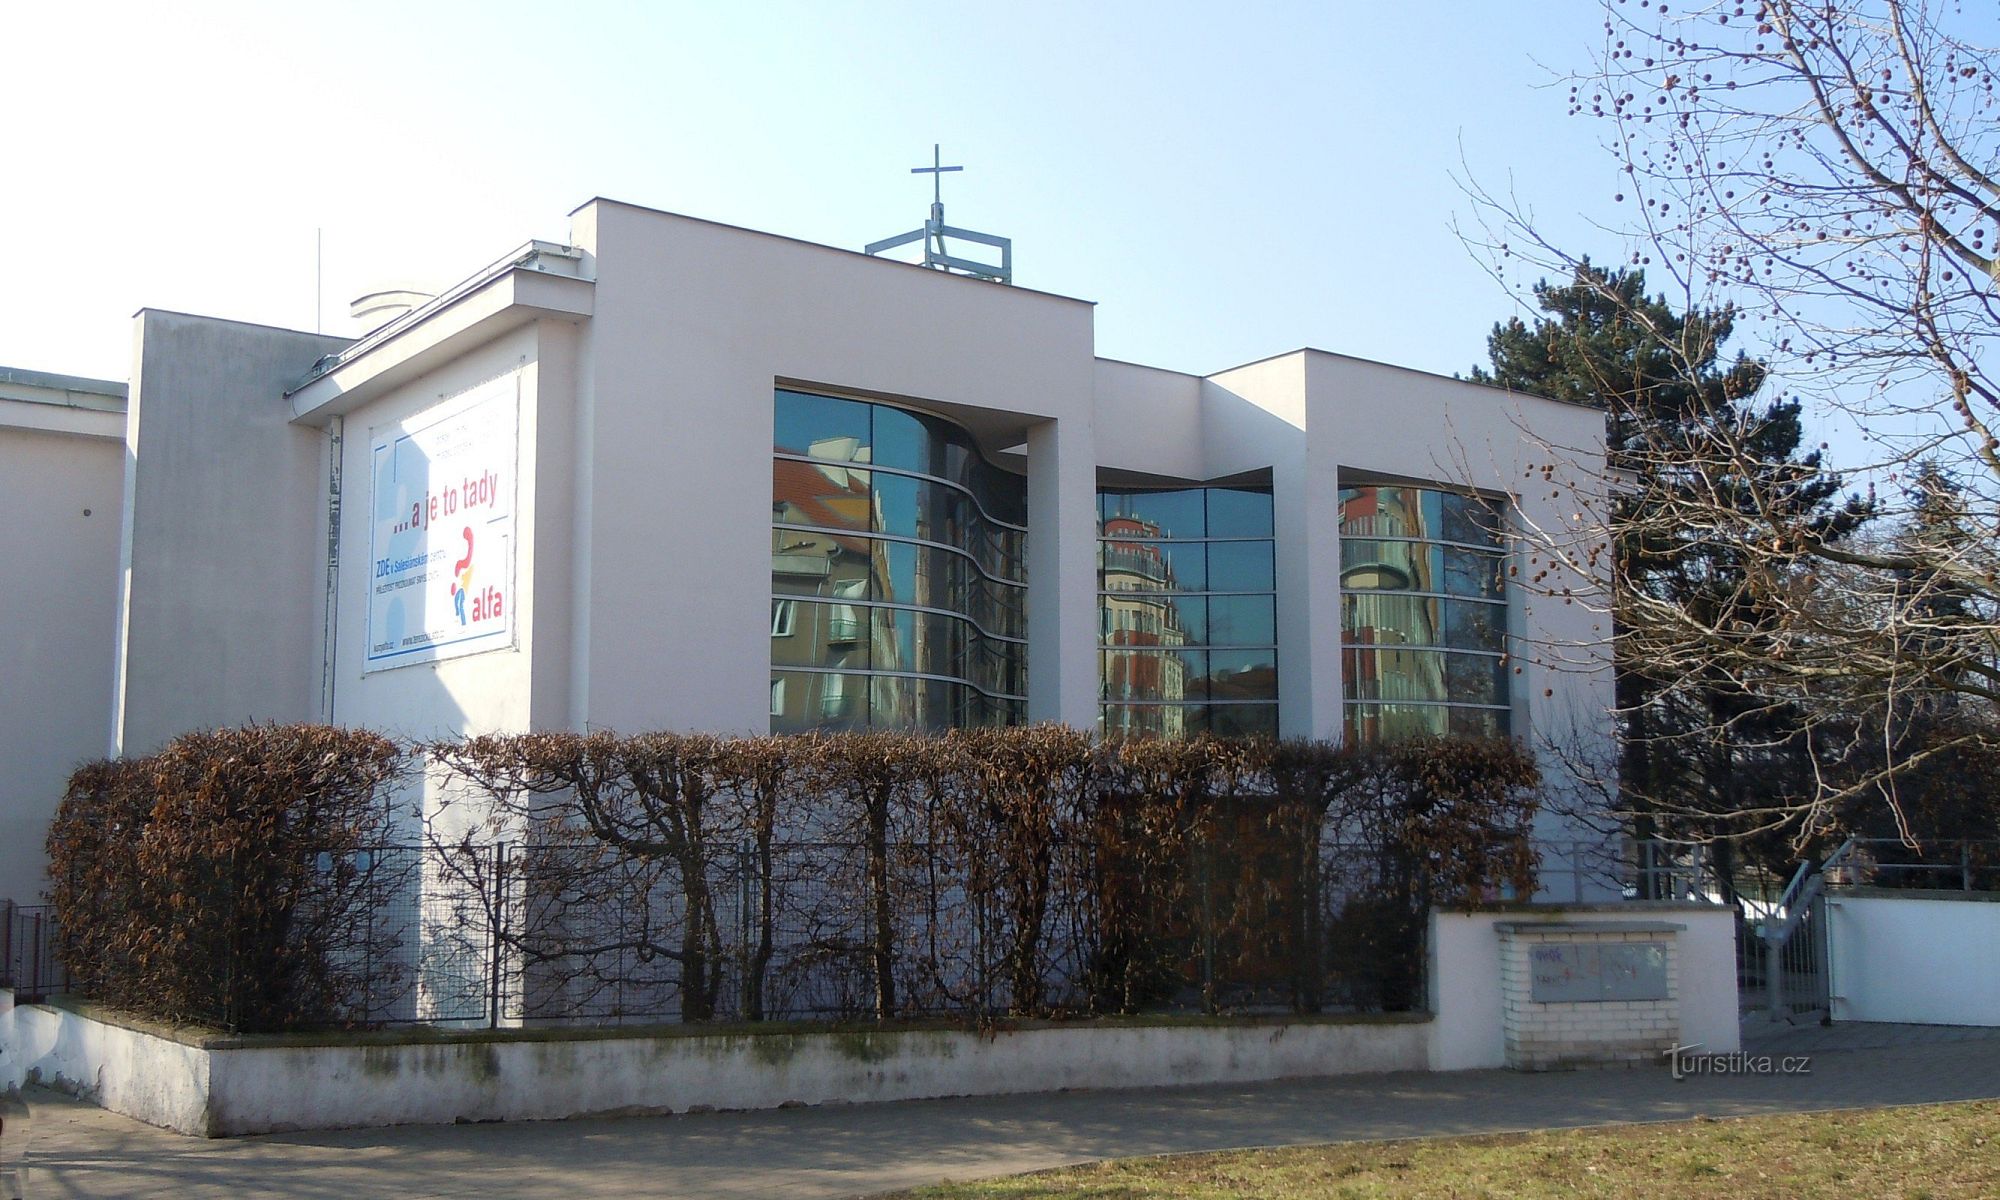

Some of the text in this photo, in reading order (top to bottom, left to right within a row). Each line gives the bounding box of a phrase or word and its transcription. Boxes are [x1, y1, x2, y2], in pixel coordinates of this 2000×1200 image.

[424, 490, 438, 531] je
[443, 485, 457, 517] to
[463, 468, 498, 509] tady
[376, 558, 390, 578] ZDE
[472, 584, 503, 622] alfa
